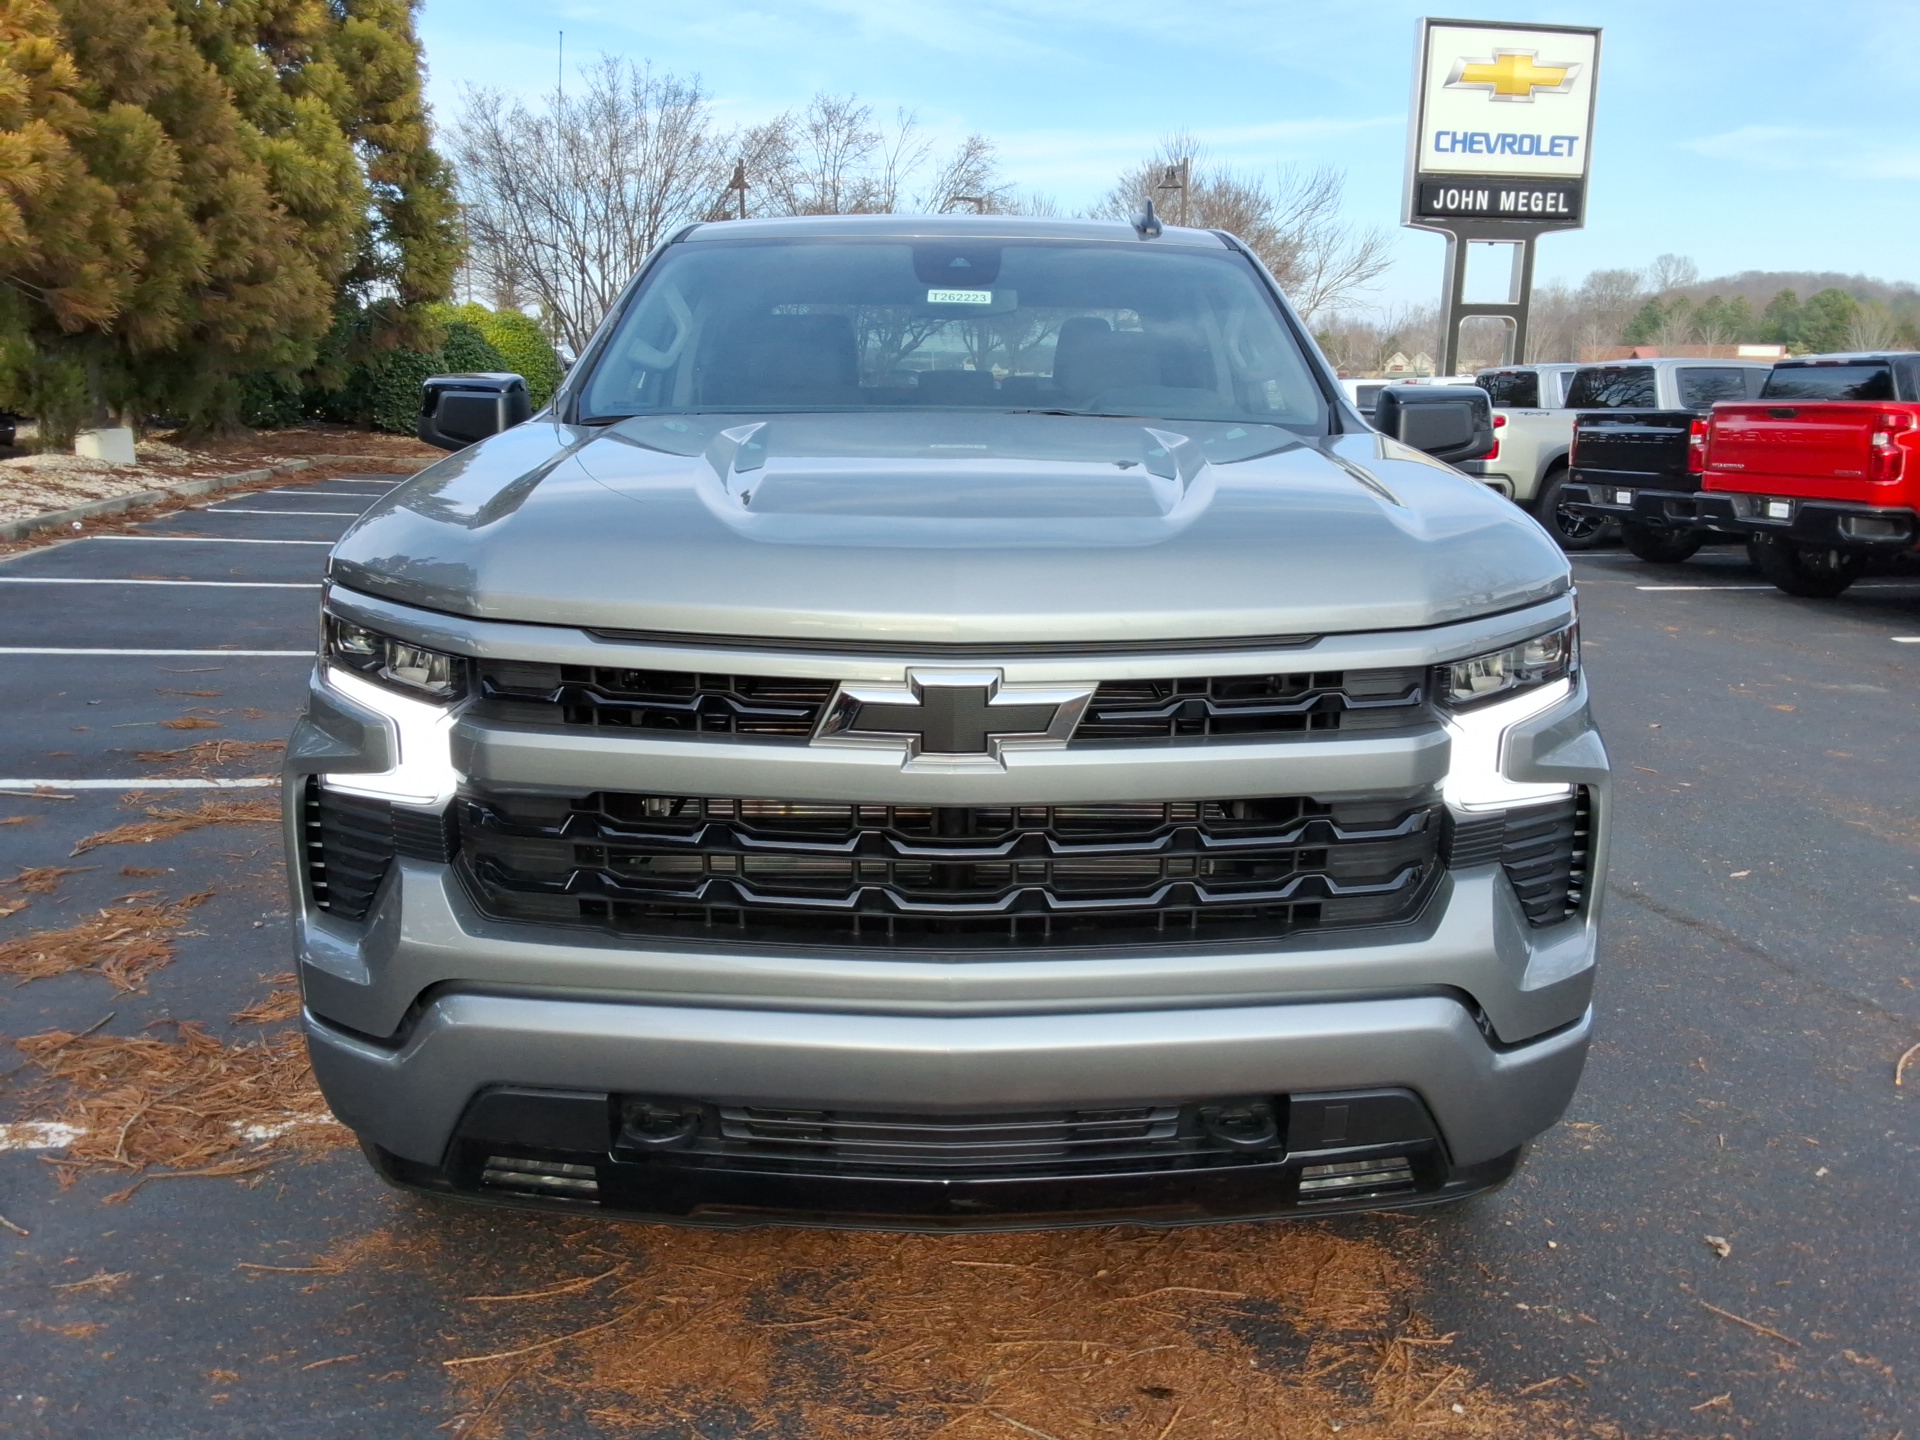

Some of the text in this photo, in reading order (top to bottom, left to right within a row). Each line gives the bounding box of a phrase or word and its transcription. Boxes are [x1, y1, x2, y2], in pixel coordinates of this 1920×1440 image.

[1434, 130, 1579, 157] CHEVROLET
[1433, 189, 1569, 213] JOHN MEGEL
[931, 292, 987, 303] T262223
